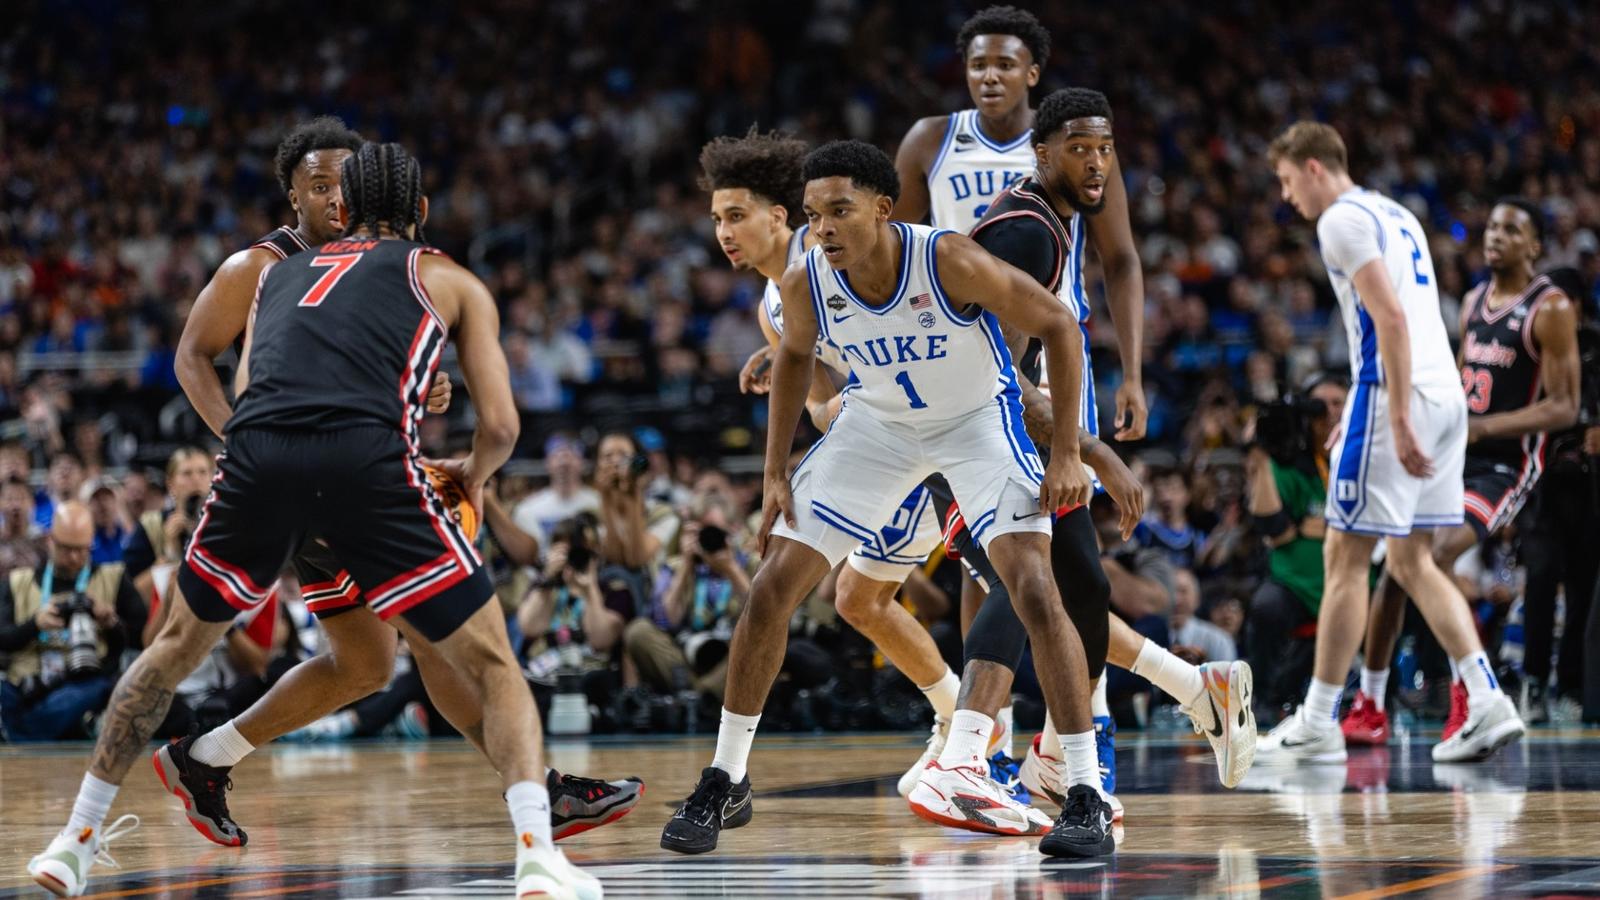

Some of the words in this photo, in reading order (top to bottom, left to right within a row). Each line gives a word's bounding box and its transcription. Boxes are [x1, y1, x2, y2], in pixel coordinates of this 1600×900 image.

[948, 170, 1023, 201] DUK
[320, 240, 379, 254] UZAN
[1400, 227, 1429, 285] 2
[297, 252, 364, 307] 7
[843, 334, 948, 367] DUKE
[895, 370, 928, 409] 1
